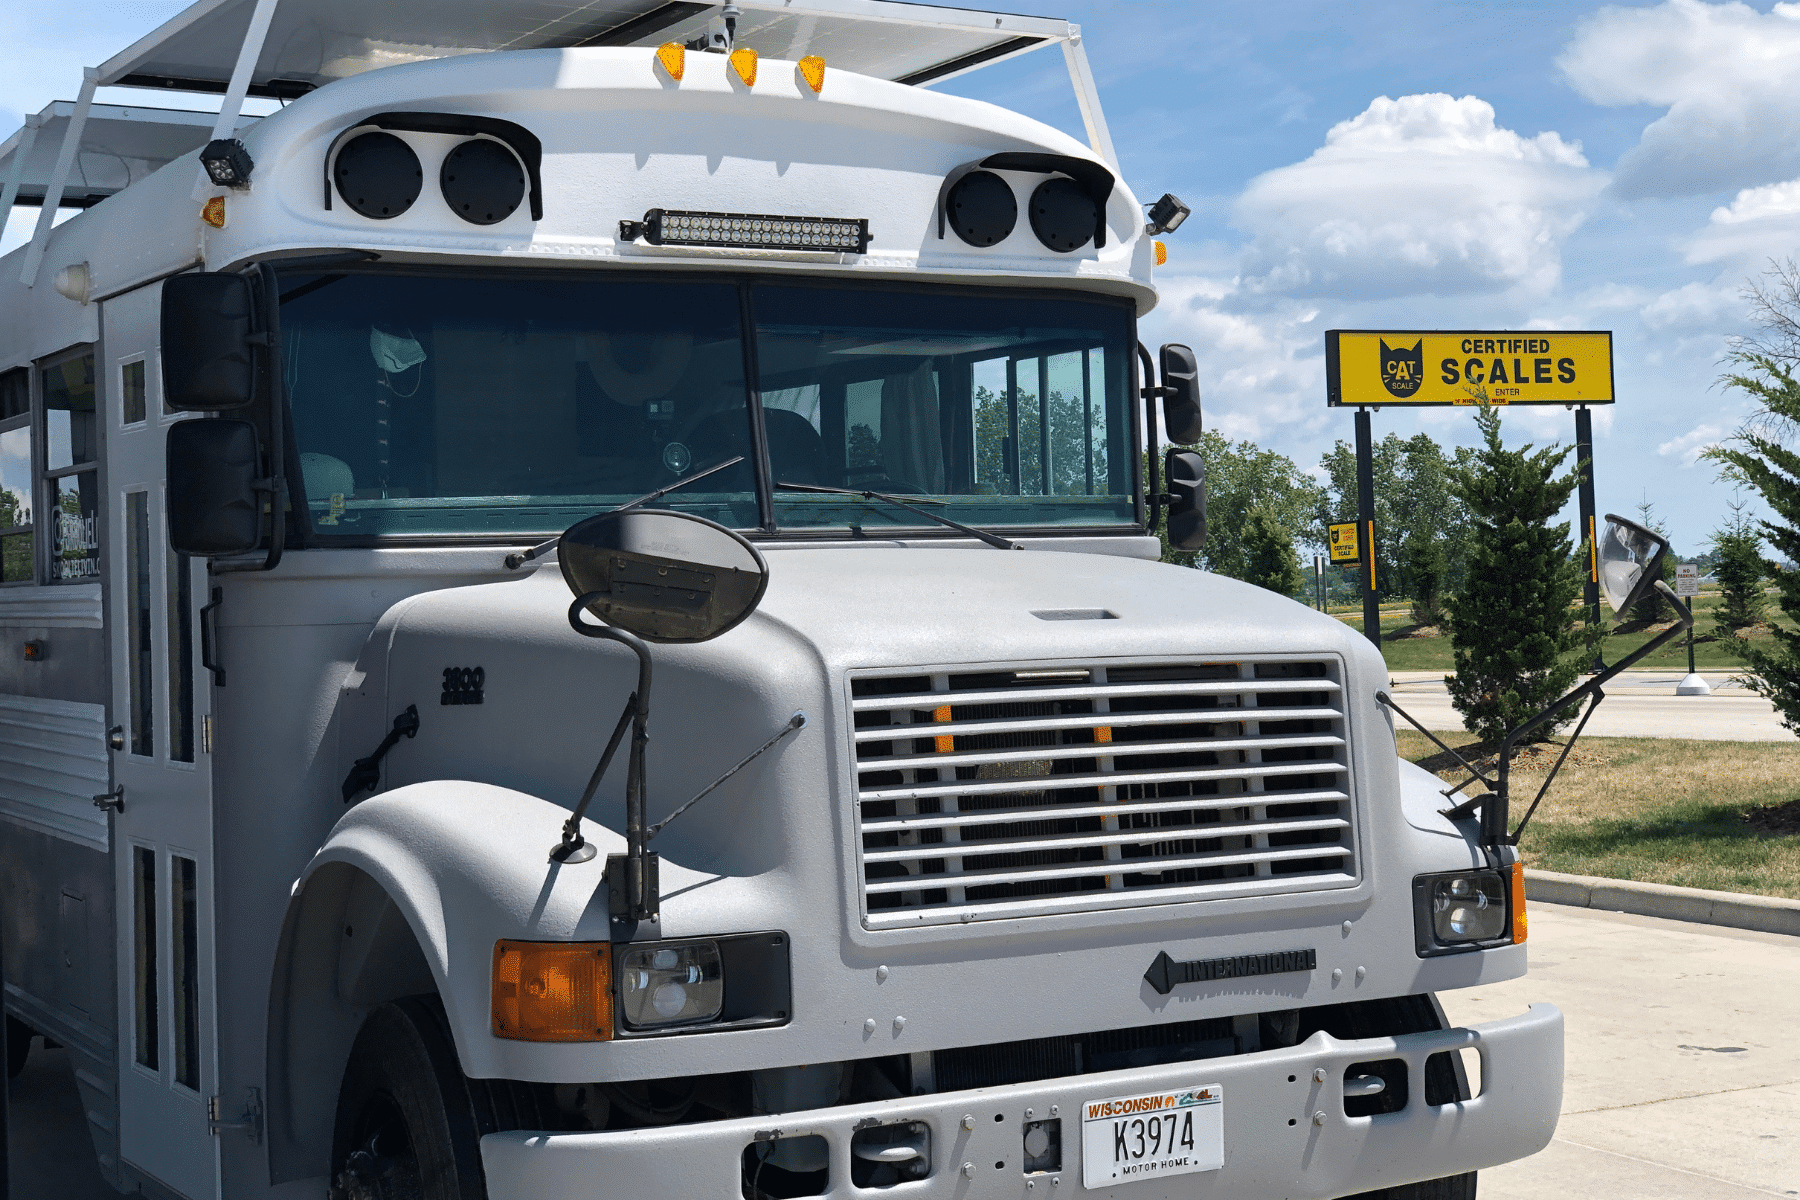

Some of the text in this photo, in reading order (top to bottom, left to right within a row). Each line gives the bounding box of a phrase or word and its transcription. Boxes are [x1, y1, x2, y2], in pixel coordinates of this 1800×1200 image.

[1461, 339, 1550, 354] CERTIFIED
[1386, 360, 1416, 380] CAT
[1441, 357, 1576, 384] SCALES
[1392, 382, 1414, 390] SCALE
[1495, 388, 1520, 396] ENTER
[1186, 949, 1316, 982] INTERNATIONAL
[1089, 1096, 1163, 1118] WISCONSIN
[1114, 1110, 1194, 1162] K3974
[1123, 1157, 1189, 1175] MOTOR HOME
